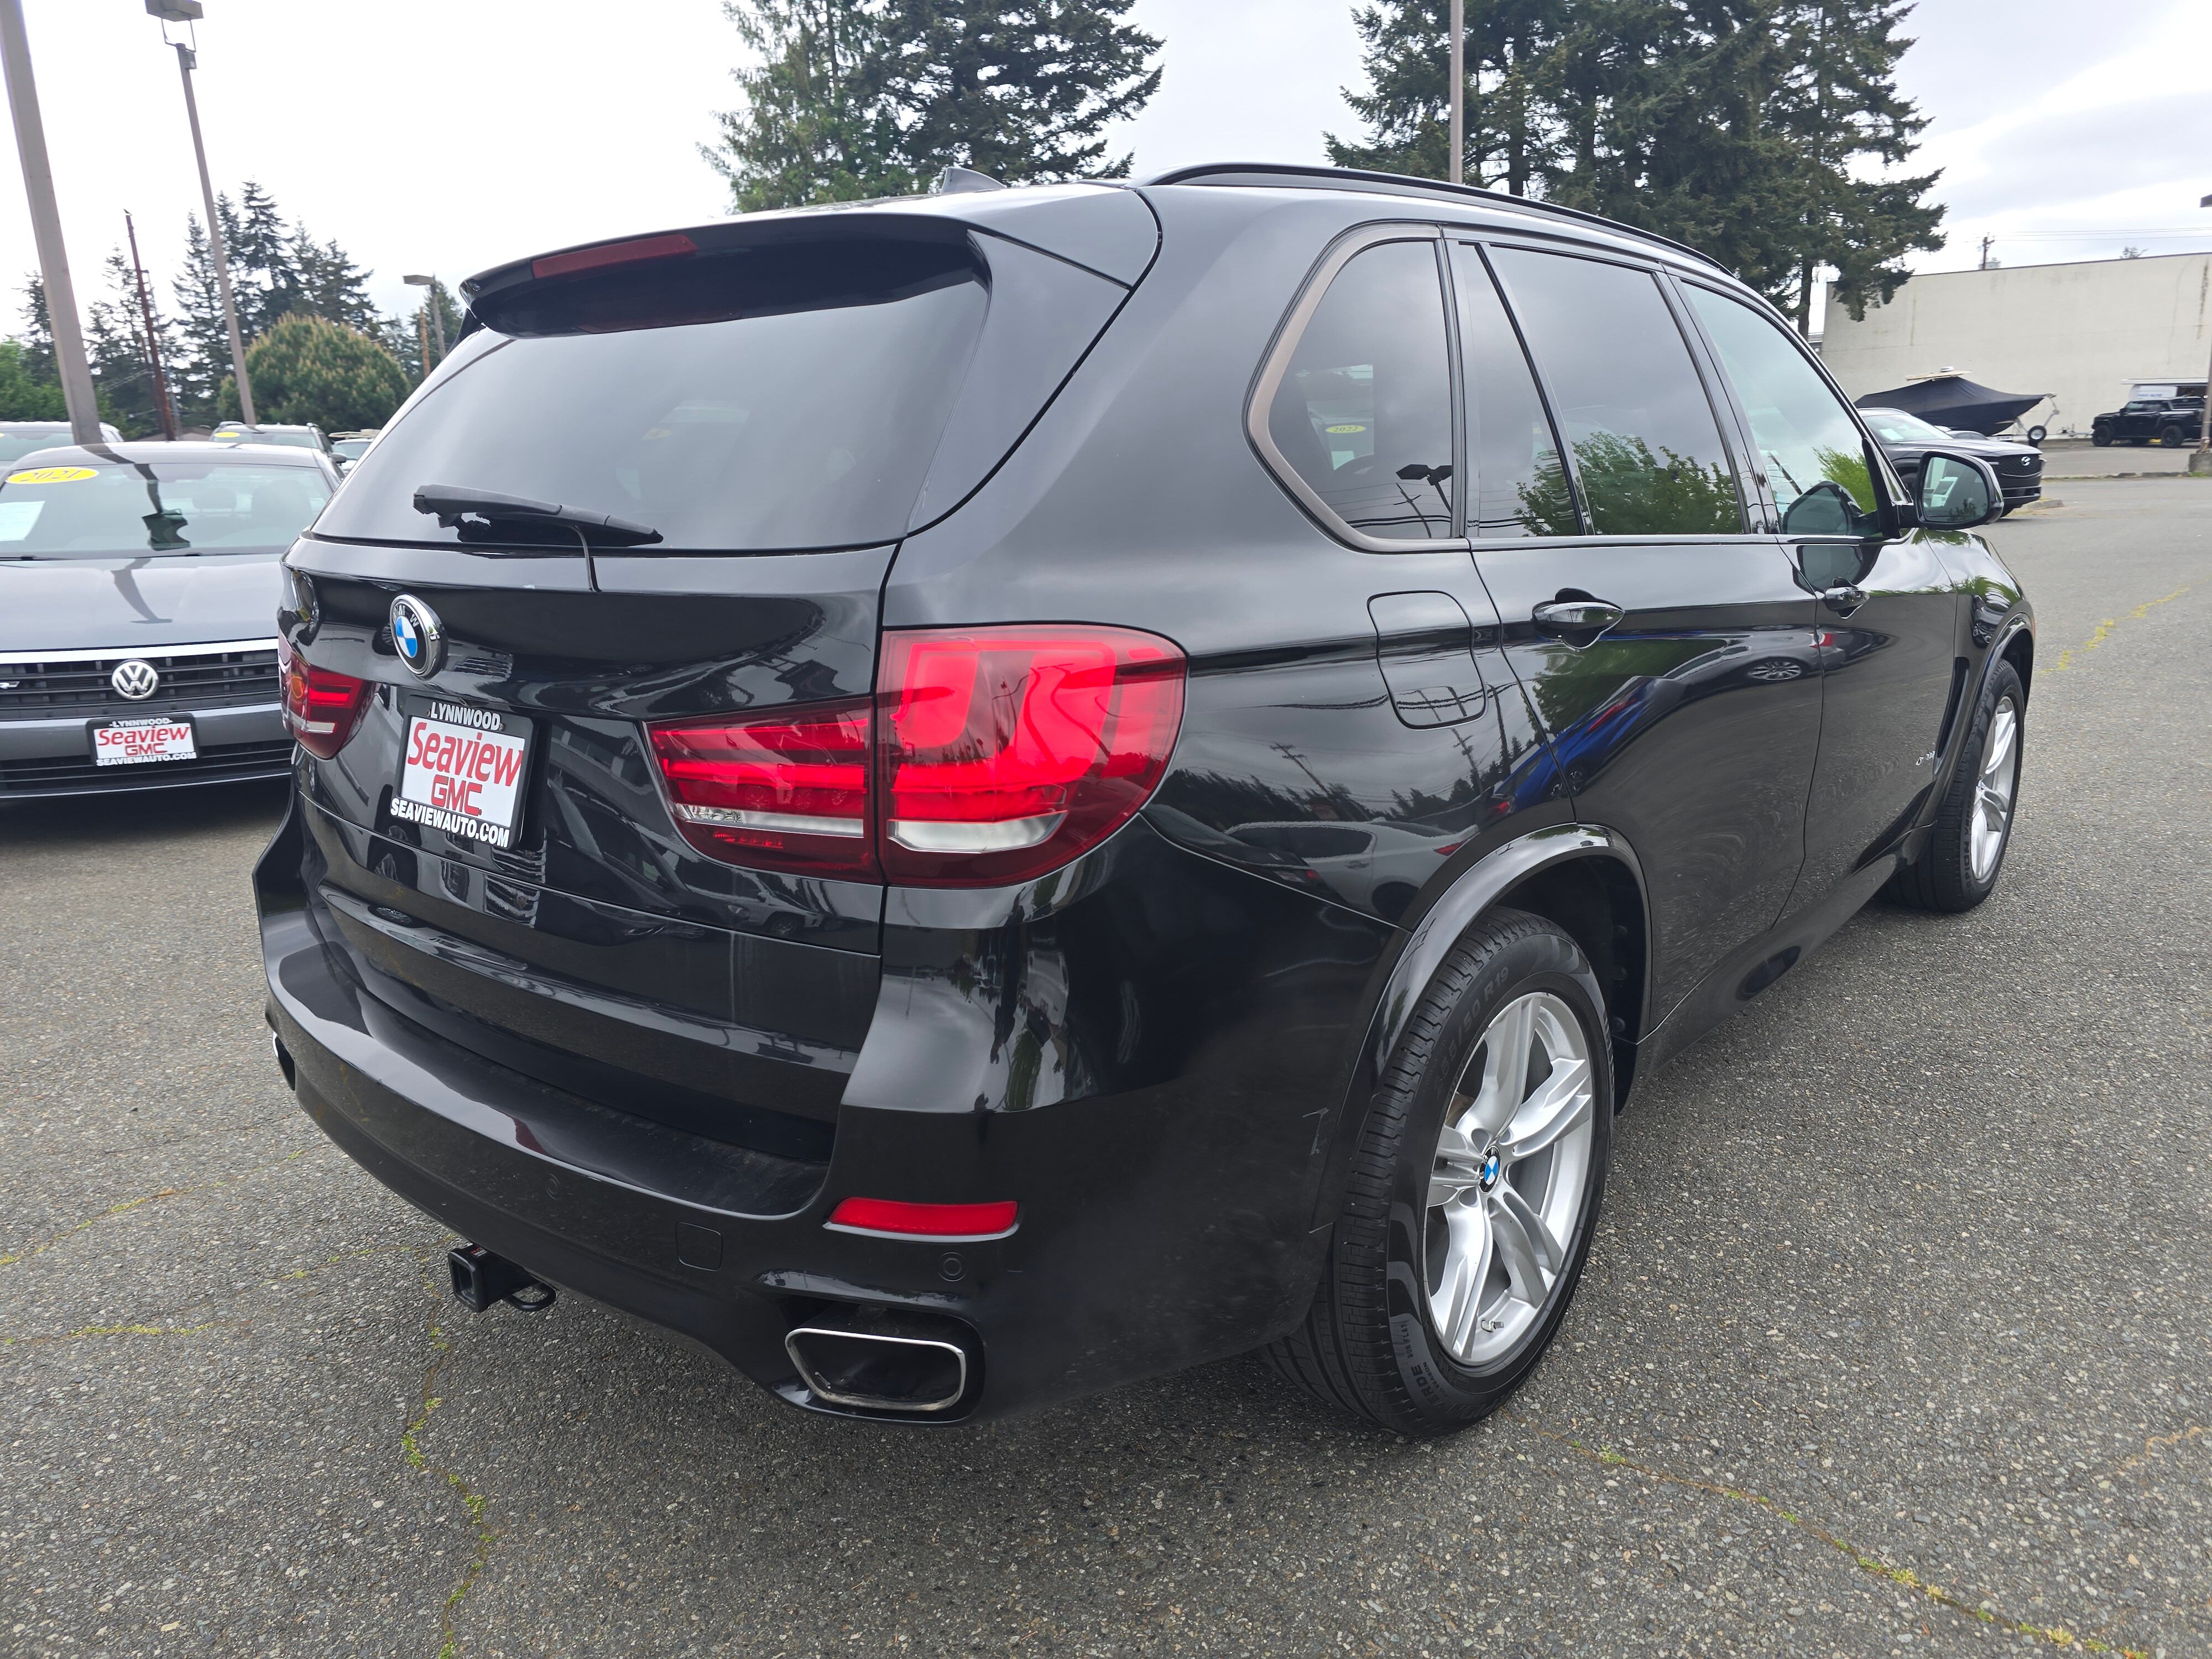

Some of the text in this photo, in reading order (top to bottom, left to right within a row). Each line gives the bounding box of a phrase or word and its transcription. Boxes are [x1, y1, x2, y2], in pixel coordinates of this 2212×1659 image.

[19, 469, 83, 482] 2021
[112, 717, 171, 728] LYNNWOOD
[430, 701, 501, 731] LYNNWOOD
[97, 726, 191, 746] Seaview
[96, 752, 197, 766] SEAVIEWAUTO.COM
[124, 742, 168, 756] GMC
[407, 722, 524, 787] Seaview
[431, 774, 483, 817] GMC
[390, 797, 510, 848] SEAVIEWAUTO.COM
